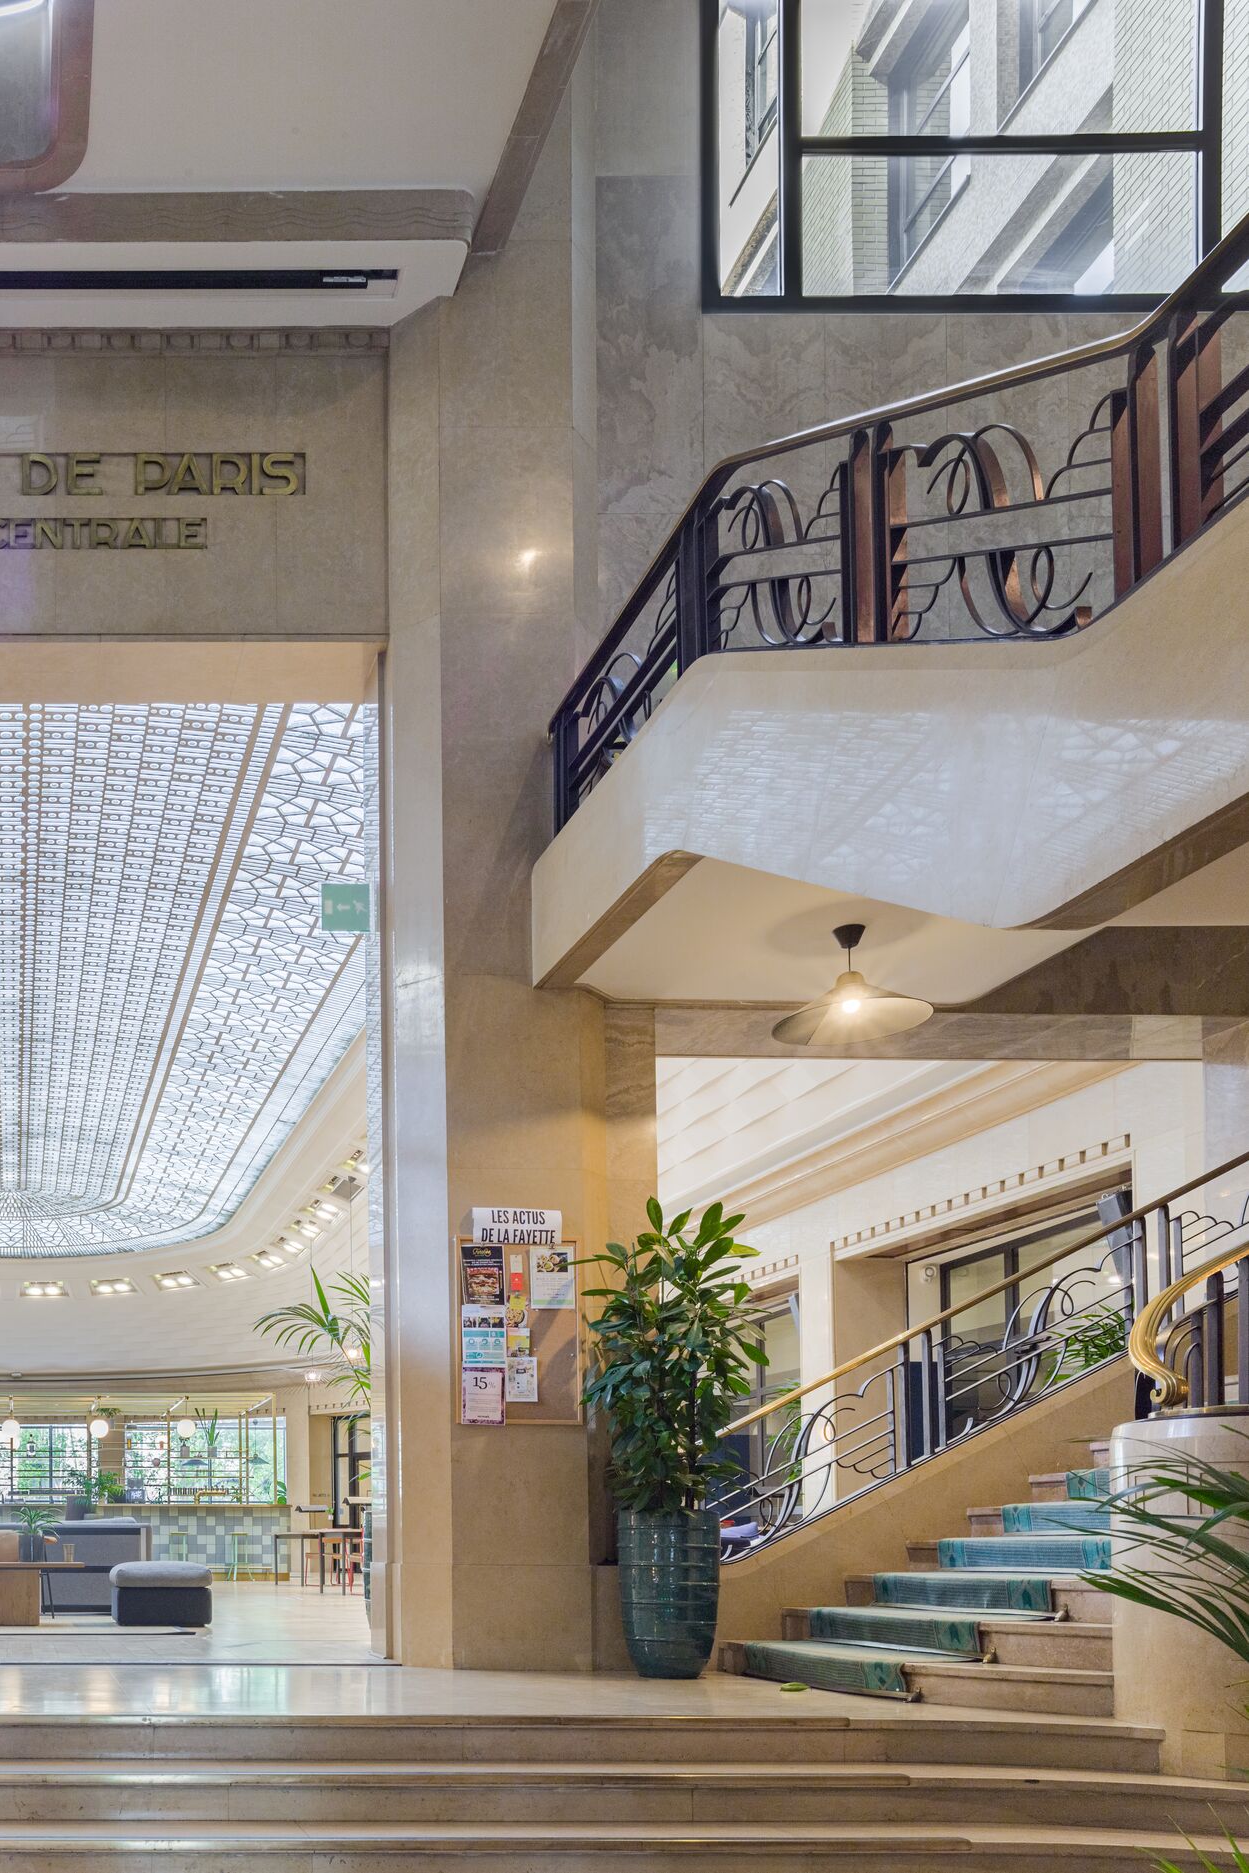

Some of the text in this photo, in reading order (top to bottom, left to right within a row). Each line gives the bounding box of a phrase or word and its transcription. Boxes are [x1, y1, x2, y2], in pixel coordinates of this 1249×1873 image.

[20, 453, 104, 496] DE
[136, 453, 298, 496] PARIS
[491, 1210, 546, 1225] LES ACTUS
[481, 1228, 556, 1245] DE LA FAYETTE
